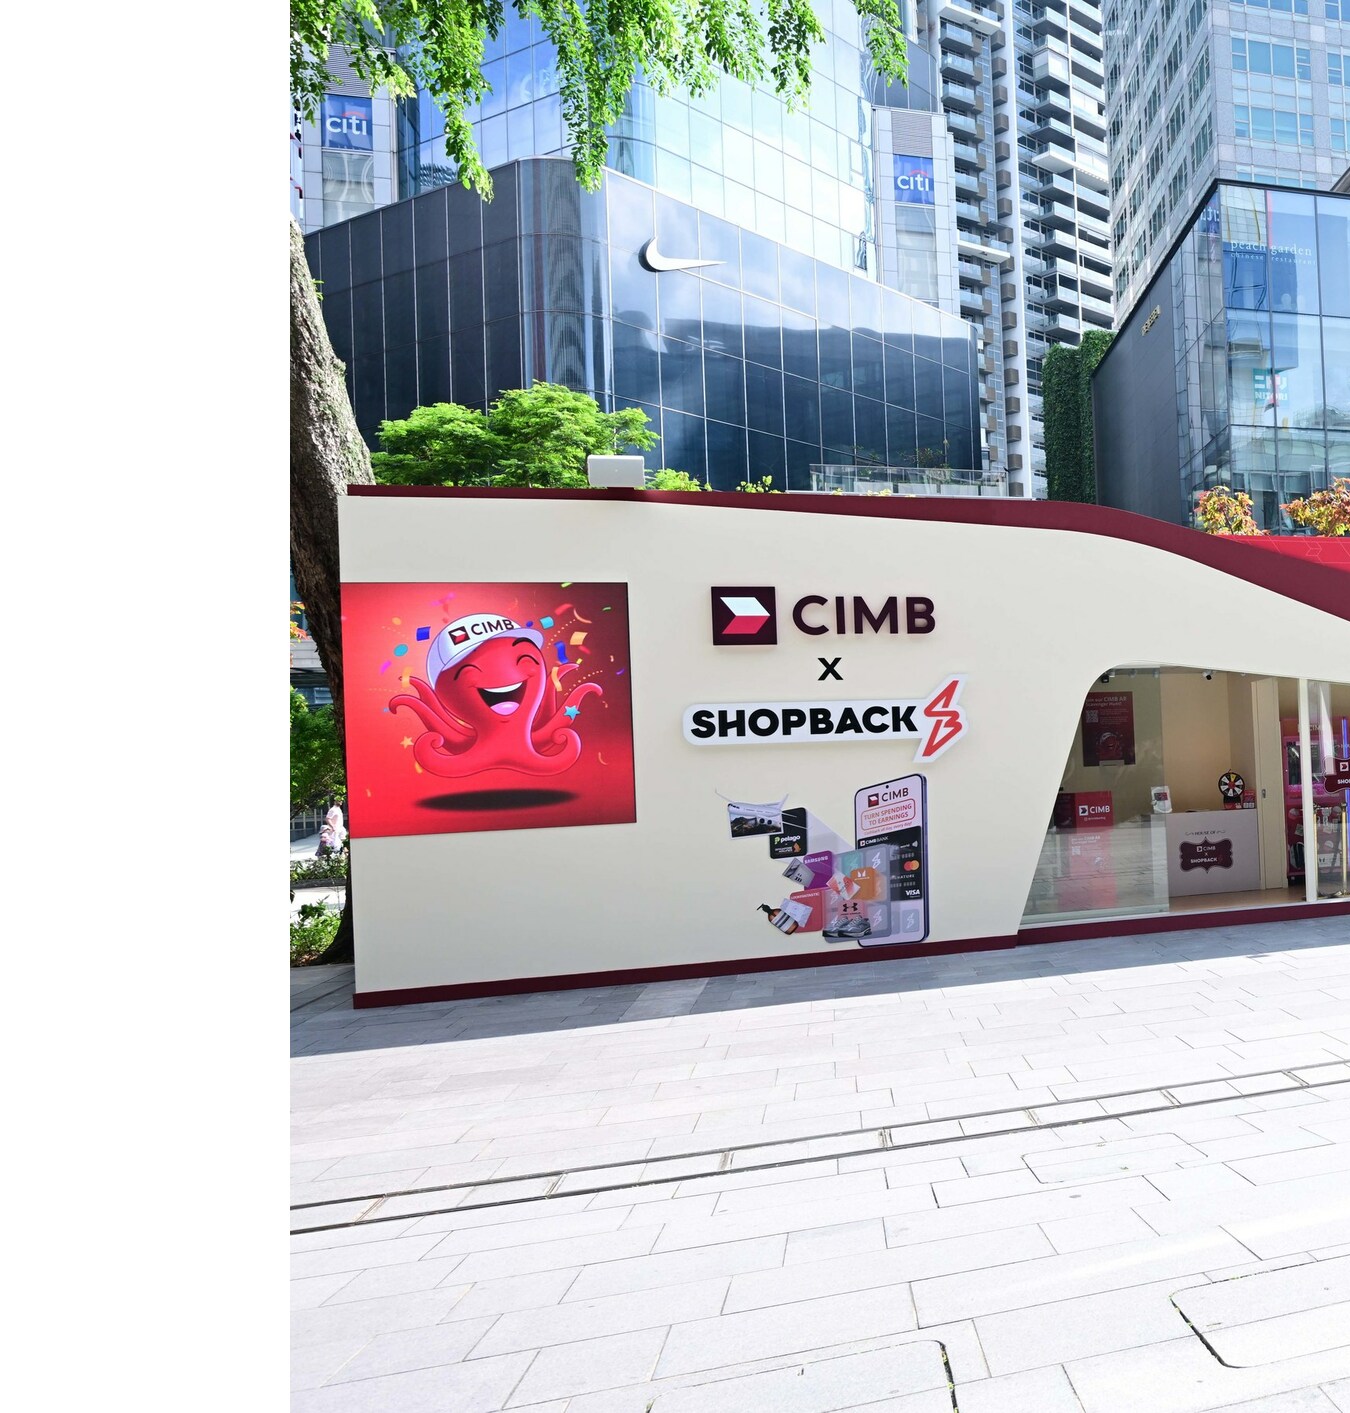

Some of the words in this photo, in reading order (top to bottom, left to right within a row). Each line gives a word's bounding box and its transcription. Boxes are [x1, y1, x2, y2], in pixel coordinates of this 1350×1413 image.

[326, 115, 367, 135] citi
[897, 174, 929, 191] citi
[1231, 241, 1266, 251] peach
[1270, 244, 1312, 256] garden
[792, 595, 936, 636] CIMB
[471, 619, 514, 635] CIMB
[690, 706, 918, 738] SHOPBACK
[882, 788, 909, 801] CIMB
[864, 812, 879, 820] TURN
[881, 804, 912, 816] SPENDING
[1090, 805, 1110, 813] CIMB
[878, 812, 908, 824] EARNINGS
[805, 855, 828, 864] SAMSUNG
